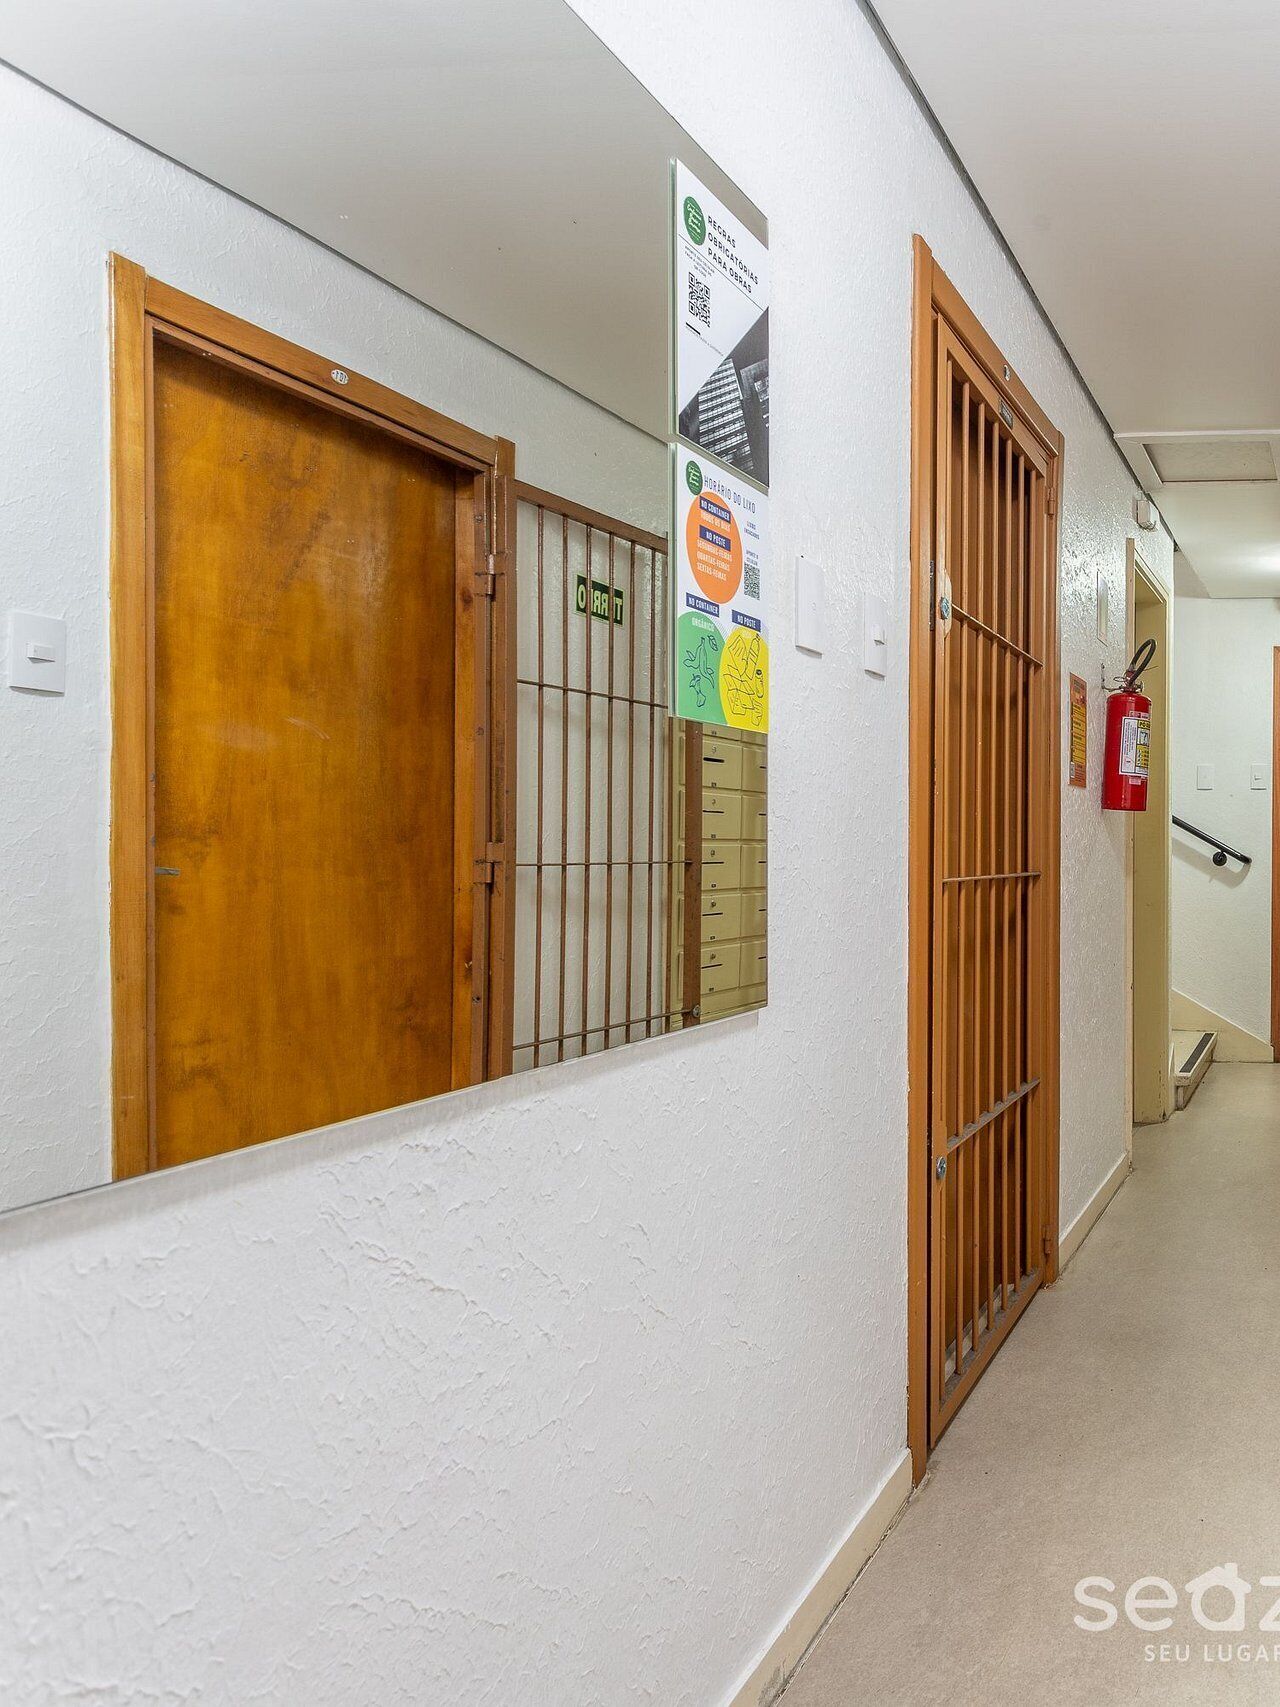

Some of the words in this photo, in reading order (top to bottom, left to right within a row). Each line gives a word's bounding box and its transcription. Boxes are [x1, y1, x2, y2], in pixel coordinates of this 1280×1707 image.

[708, 216, 736, 248] REGRAS
[708, 232, 758, 285] OBRIGATÓRIAS
[708, 248, 728, 271] PARA
[729, 267, 752, 293] OBRAS
[704, 475, 731, 500] HORÁRIO
[733, 492, 741, 506] DO
[743, 497, 756, 514] LIXO
[708, 503, 730, 521] CONTAINER
[713, 534, 726, 548] POSTE
[695, 599, 718, 614] CONTAINER
[744, 617, 756, 628] POSTE
